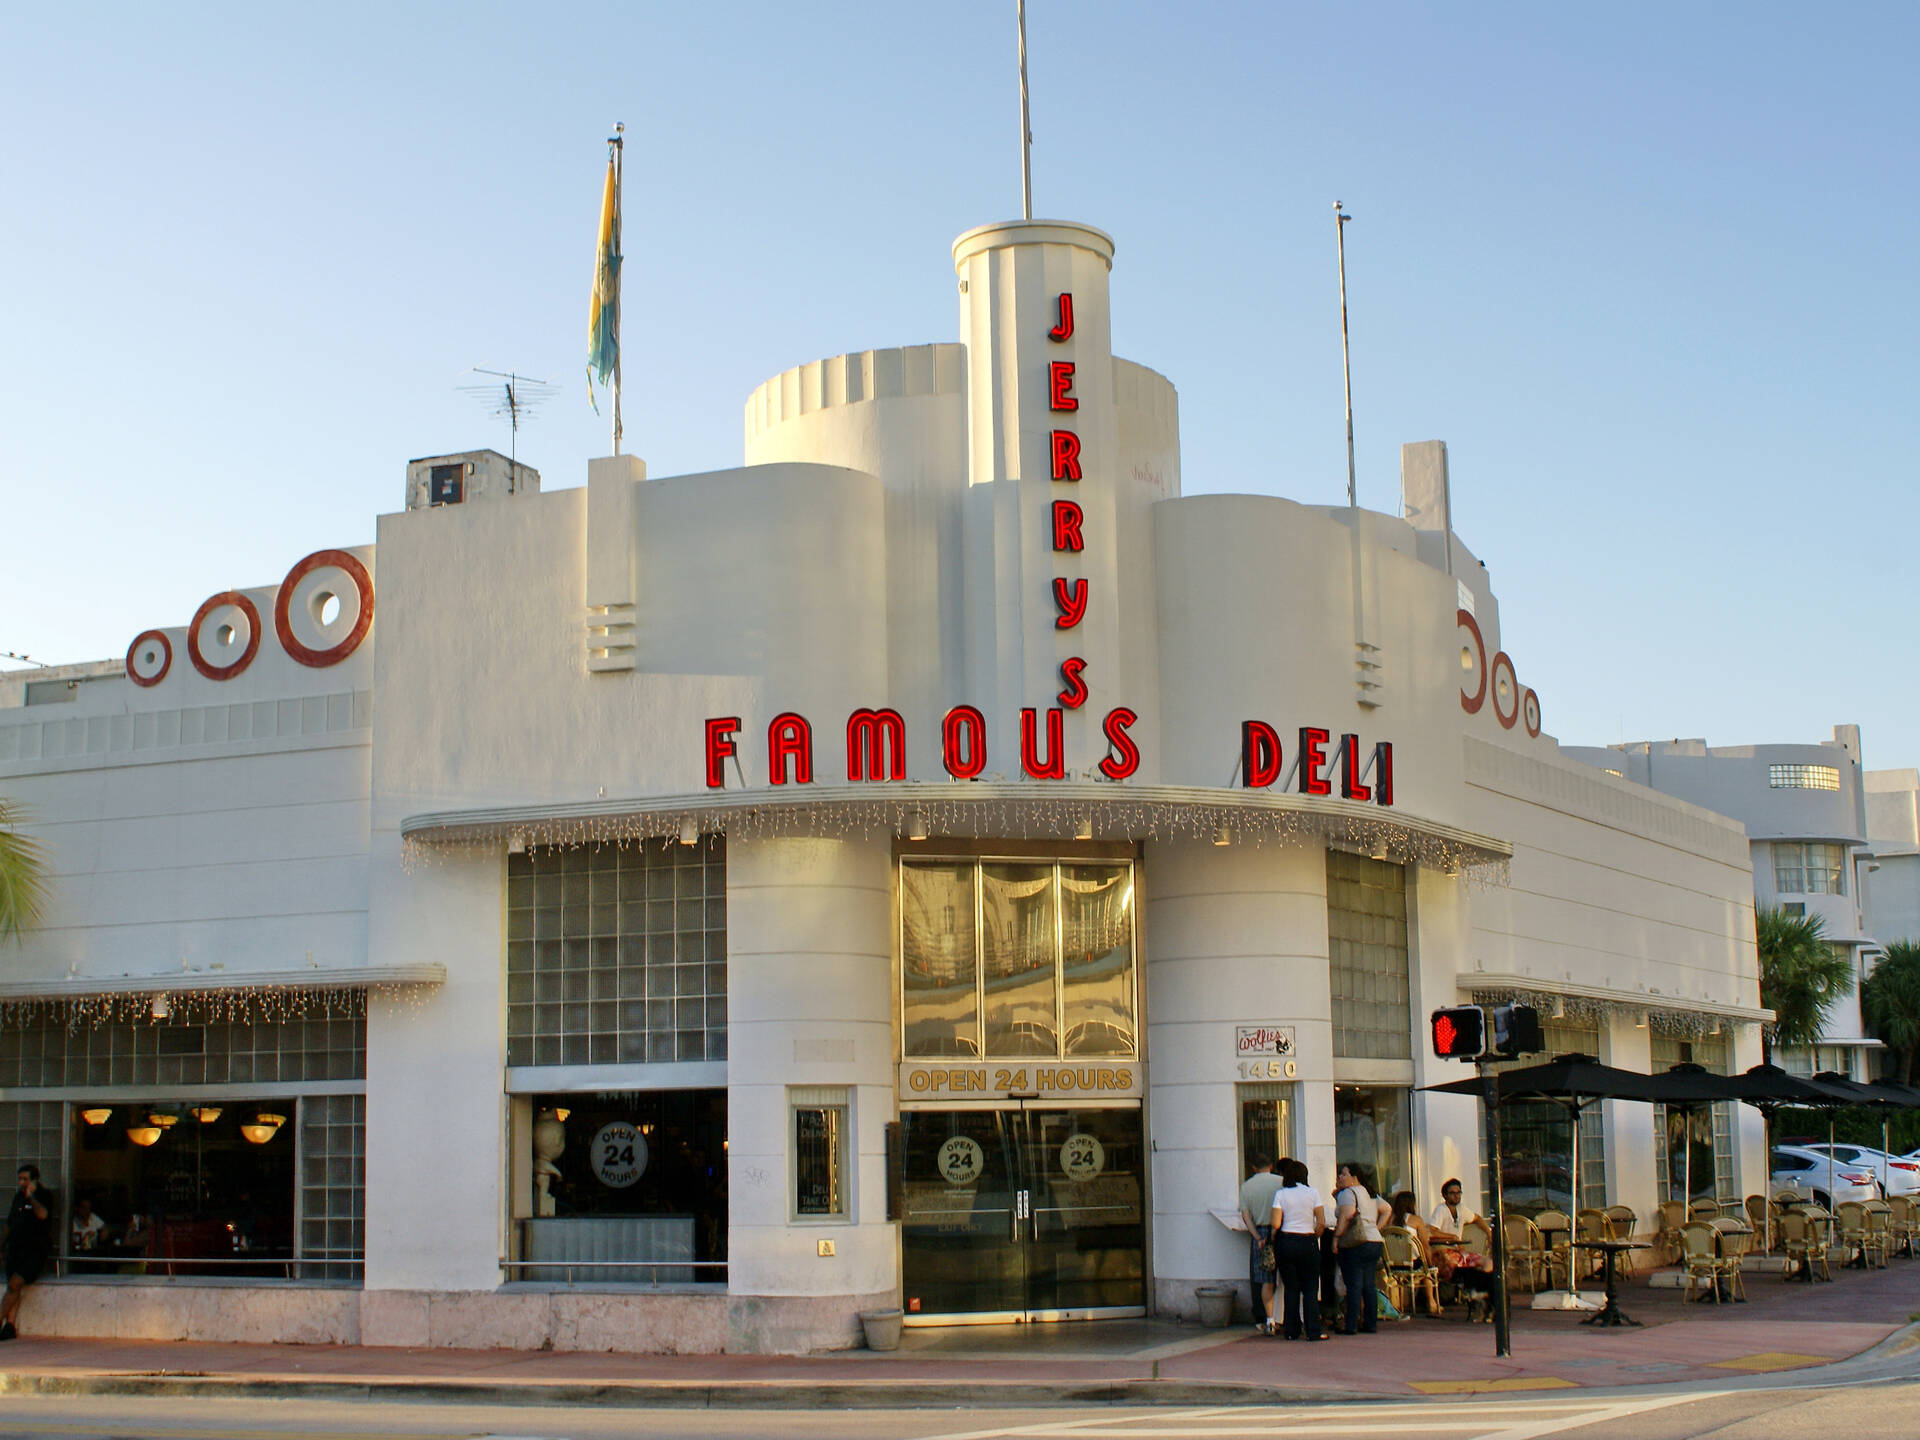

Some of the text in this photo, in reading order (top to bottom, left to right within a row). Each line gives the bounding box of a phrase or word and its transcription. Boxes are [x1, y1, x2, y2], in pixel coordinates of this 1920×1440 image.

[1048, 293, 1089, 709] JERRYS
[705, 704, 1393, 806] FAMOUS DELI
[1237, 1060, 1297, 1079] 1450
[910, 1068, 1133, 1091] OPEN 24 HOURS
[602, 1128, 636, 1143] OPEN
[1069, 1138, 1096, 1149] OPEN
[946, 1141, 974, 1151] OPEN
[603, 1145, 635, 1166] 24
[948, 1153, 974, 1169] 24
[1070, 1150, 1096, 1166] 24
[601, 1167, 638, 1183] HOURS
[946, 1170, 976, 1181] HOURS
